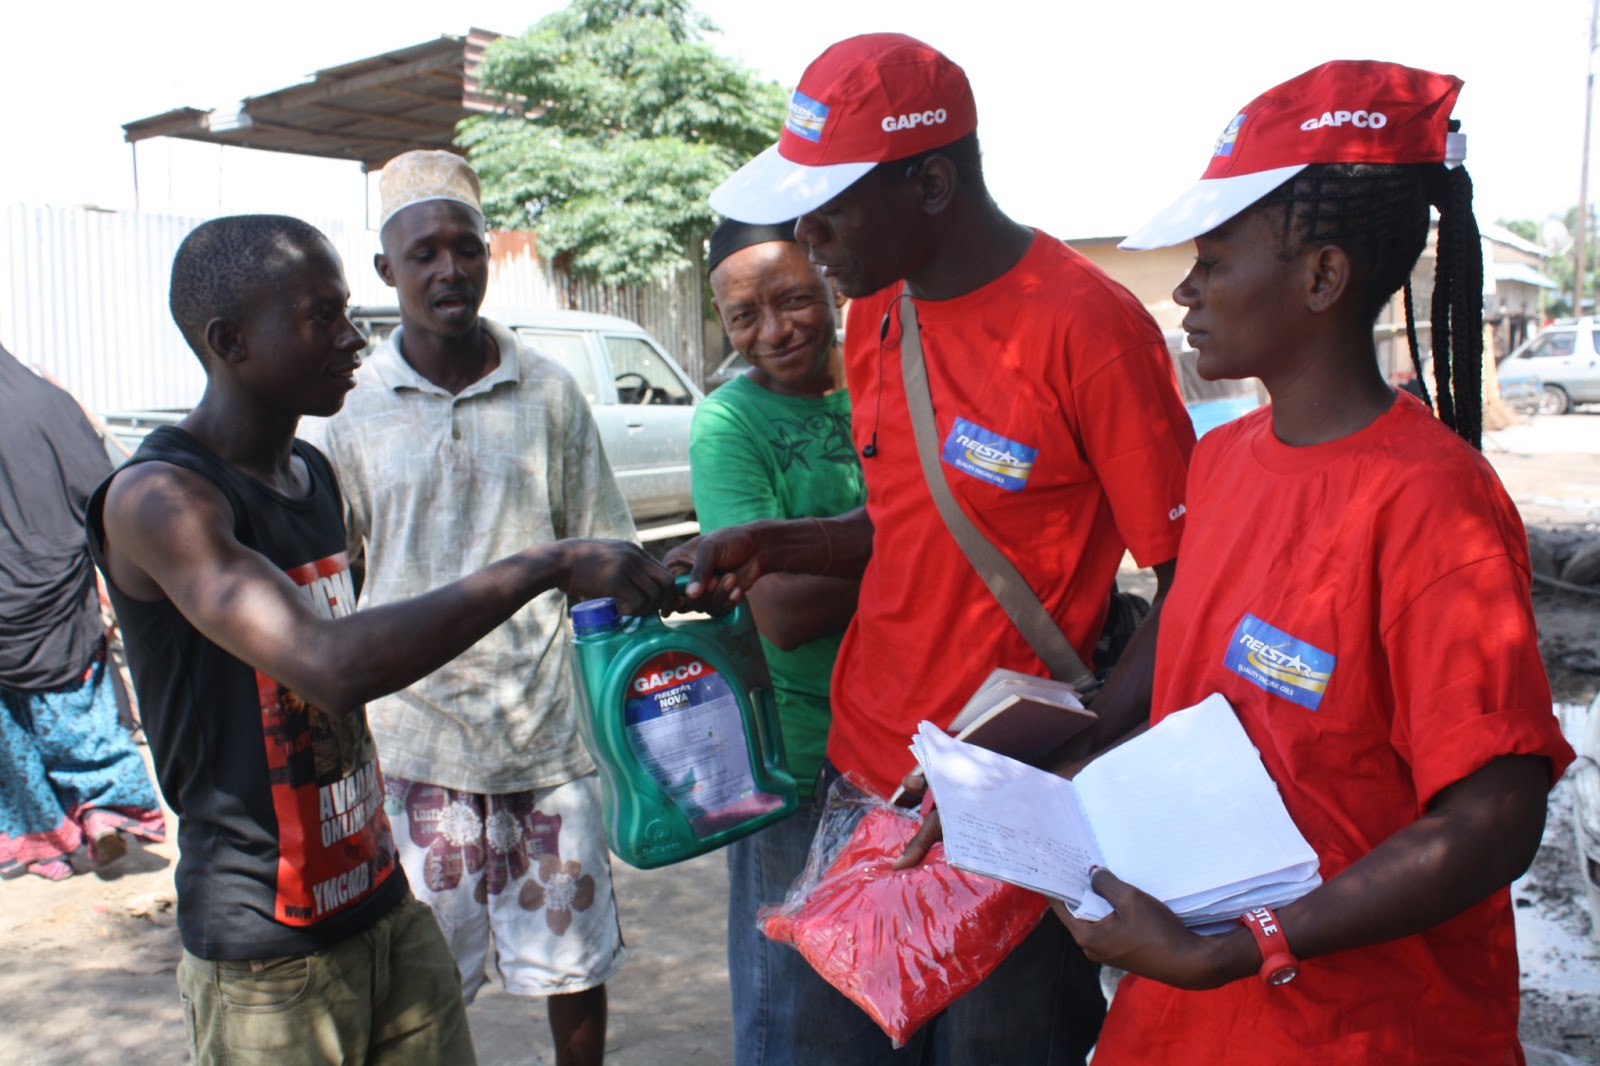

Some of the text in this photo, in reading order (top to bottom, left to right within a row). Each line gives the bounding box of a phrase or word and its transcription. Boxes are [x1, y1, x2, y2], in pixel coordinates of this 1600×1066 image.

[881, 108, 948, 132] GAPCO
[1300, 110, 1387, 131] GAPCO
[956, 434, 1020, 468] RELSTAR
[1239, 633, 1313, 679] RELSTAR
[633, 661, 703, 692] GAPCO
[1237, 663, 1295, 696] QUALITY ENGINE OILS
[659, 693, 688, 709] NOVA
[1252, 907, 1278, 937] STLE
